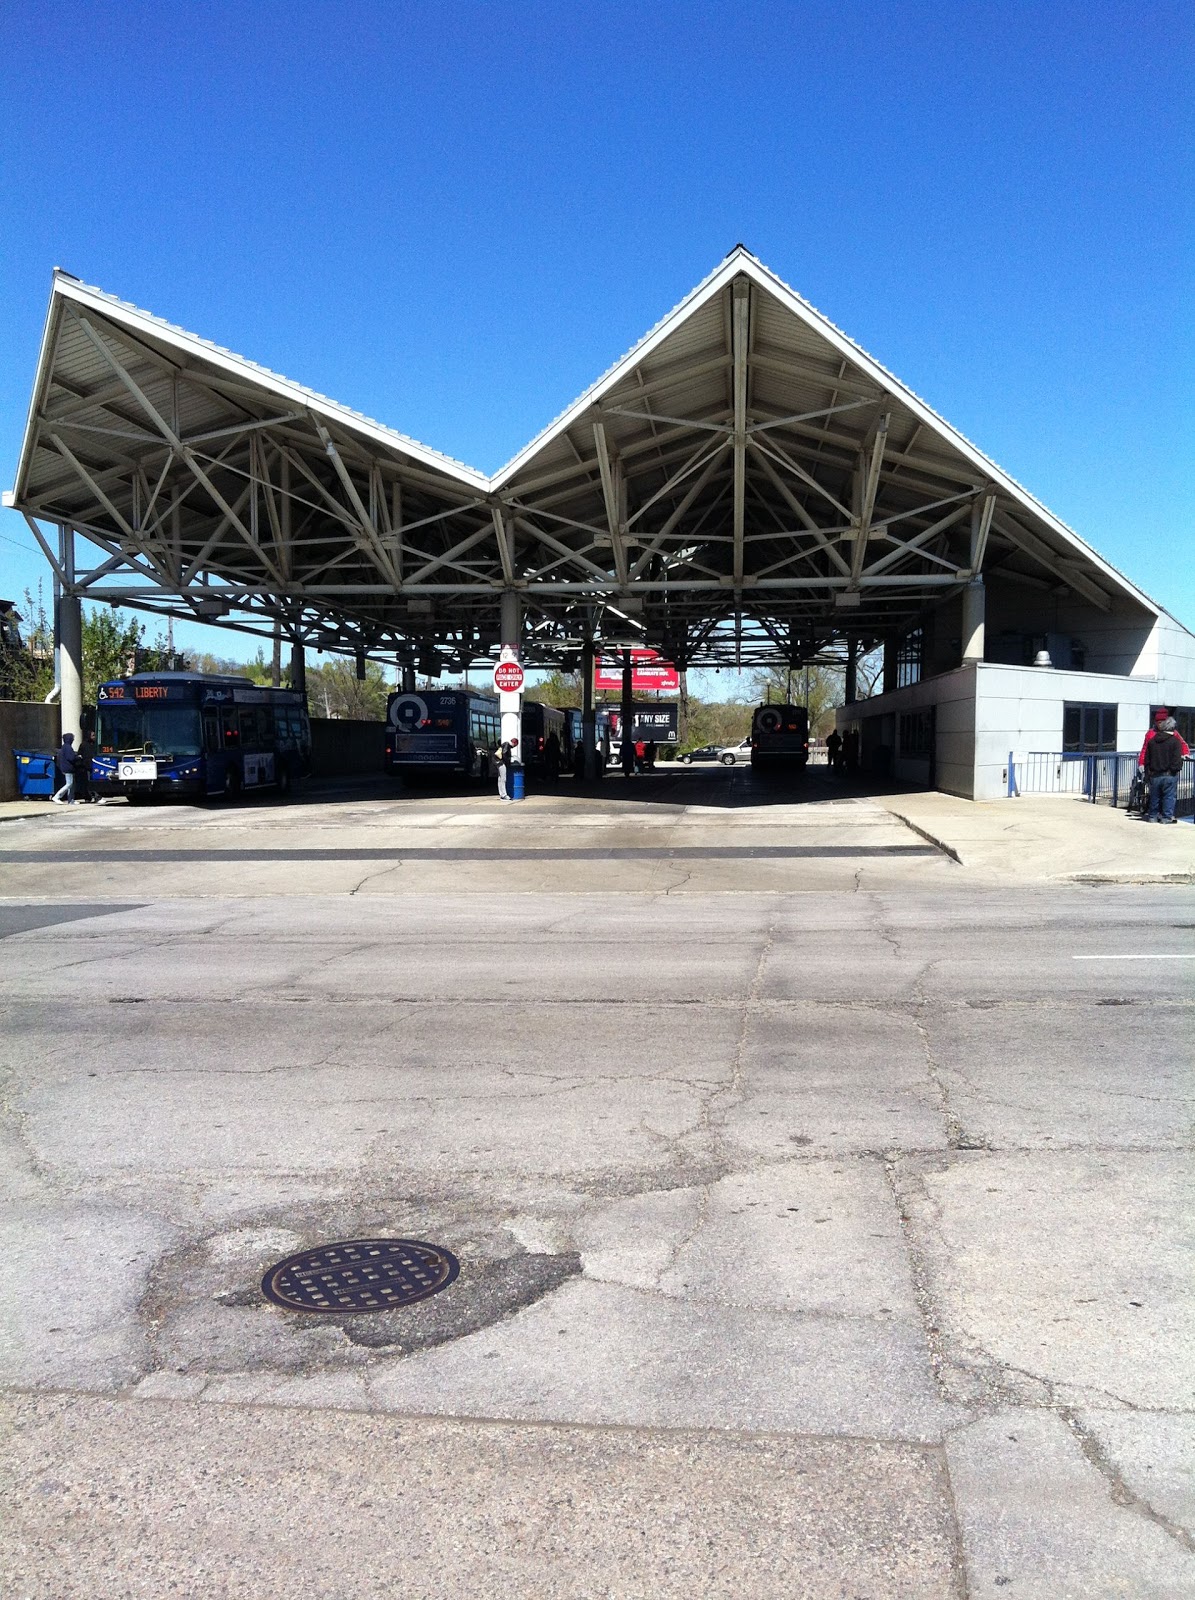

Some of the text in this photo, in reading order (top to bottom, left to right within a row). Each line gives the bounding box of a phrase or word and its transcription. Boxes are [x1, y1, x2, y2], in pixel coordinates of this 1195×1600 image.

[108, 686, 169, 698] 542 LIBERTY
[654, 714, 670, 724] SIZE
